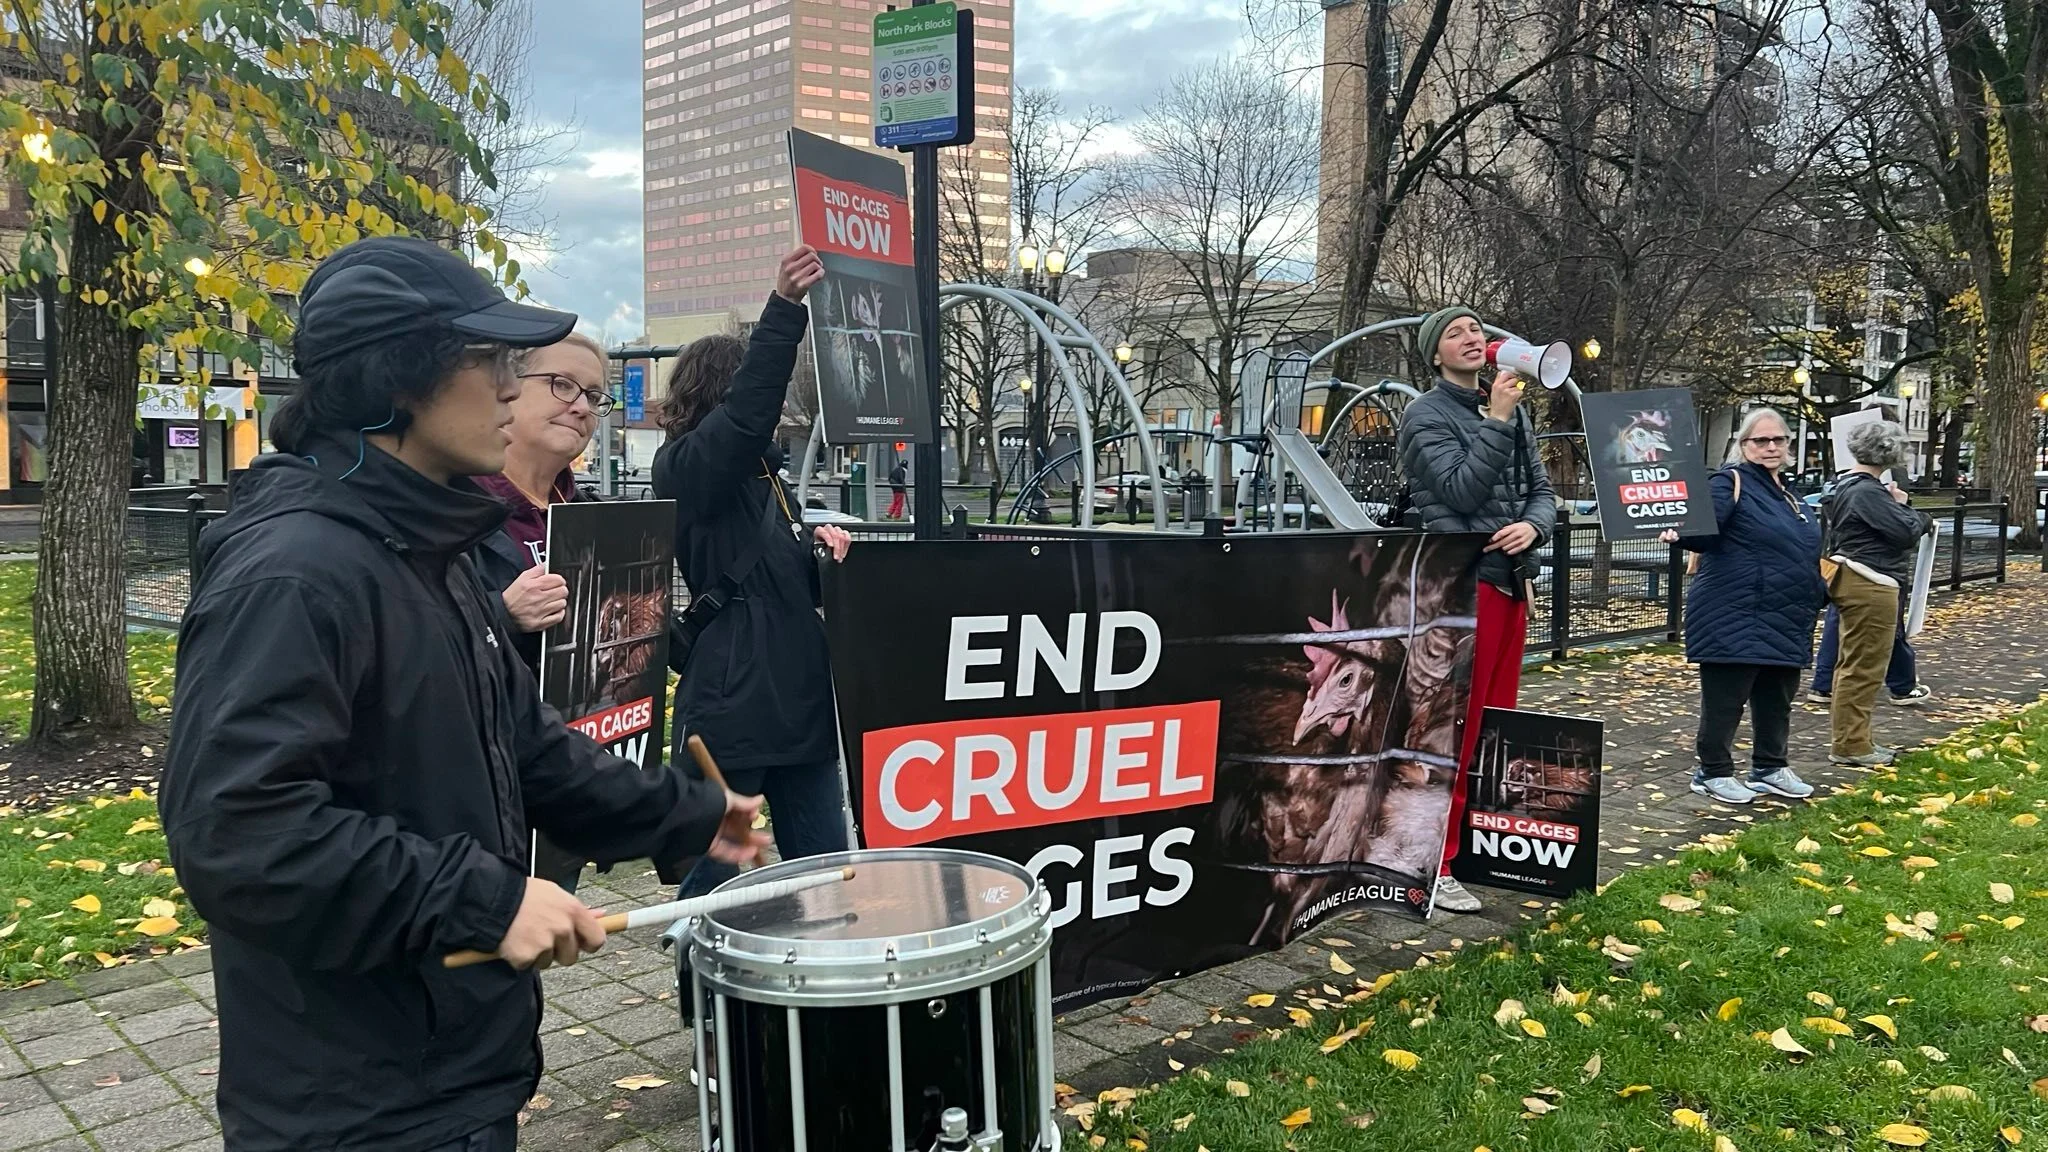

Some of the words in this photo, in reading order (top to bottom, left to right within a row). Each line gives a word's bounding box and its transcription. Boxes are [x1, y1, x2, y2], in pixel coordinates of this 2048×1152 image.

[878, 26, 902, 38] North
[904, 23, 923, 34] Park
[924, 18, 952, 30] Blocks
[887, 126, 900, 135] 311
[823, 187, 849, 208] END
[852, 195, 890, 219] CAGES
[826, 208, 891, 256] NOW
[1631, 468, 1670, 483] END
[1624, 485, 1685, 501] CRUEL
[1627, 501, 1688, 518] CAGES
[945, 610, 1162, 701] END
[601, 702, 650, 739] CAGES
[878, 719, 1204, 831] CRUEL
[1472, 813, 1511, 830] END
[1514, 820, 1577, 841] CAGES
[1472, 829, 1576, 869] NOW
[1024, 826, 1195, 929] GES
[1491, 871, 1521, 881] HUMANE
[1521, 875, 1547, 885] LEAGUE
[1296, 892, 1342, 927] HUMANE
[1341, 885, 1406, 903] LEAGUE
[1052, 989, 1083, 1003] esentative
[1083, 985, 1091, 995] of
[1117, 979, 1140, 988] factory
